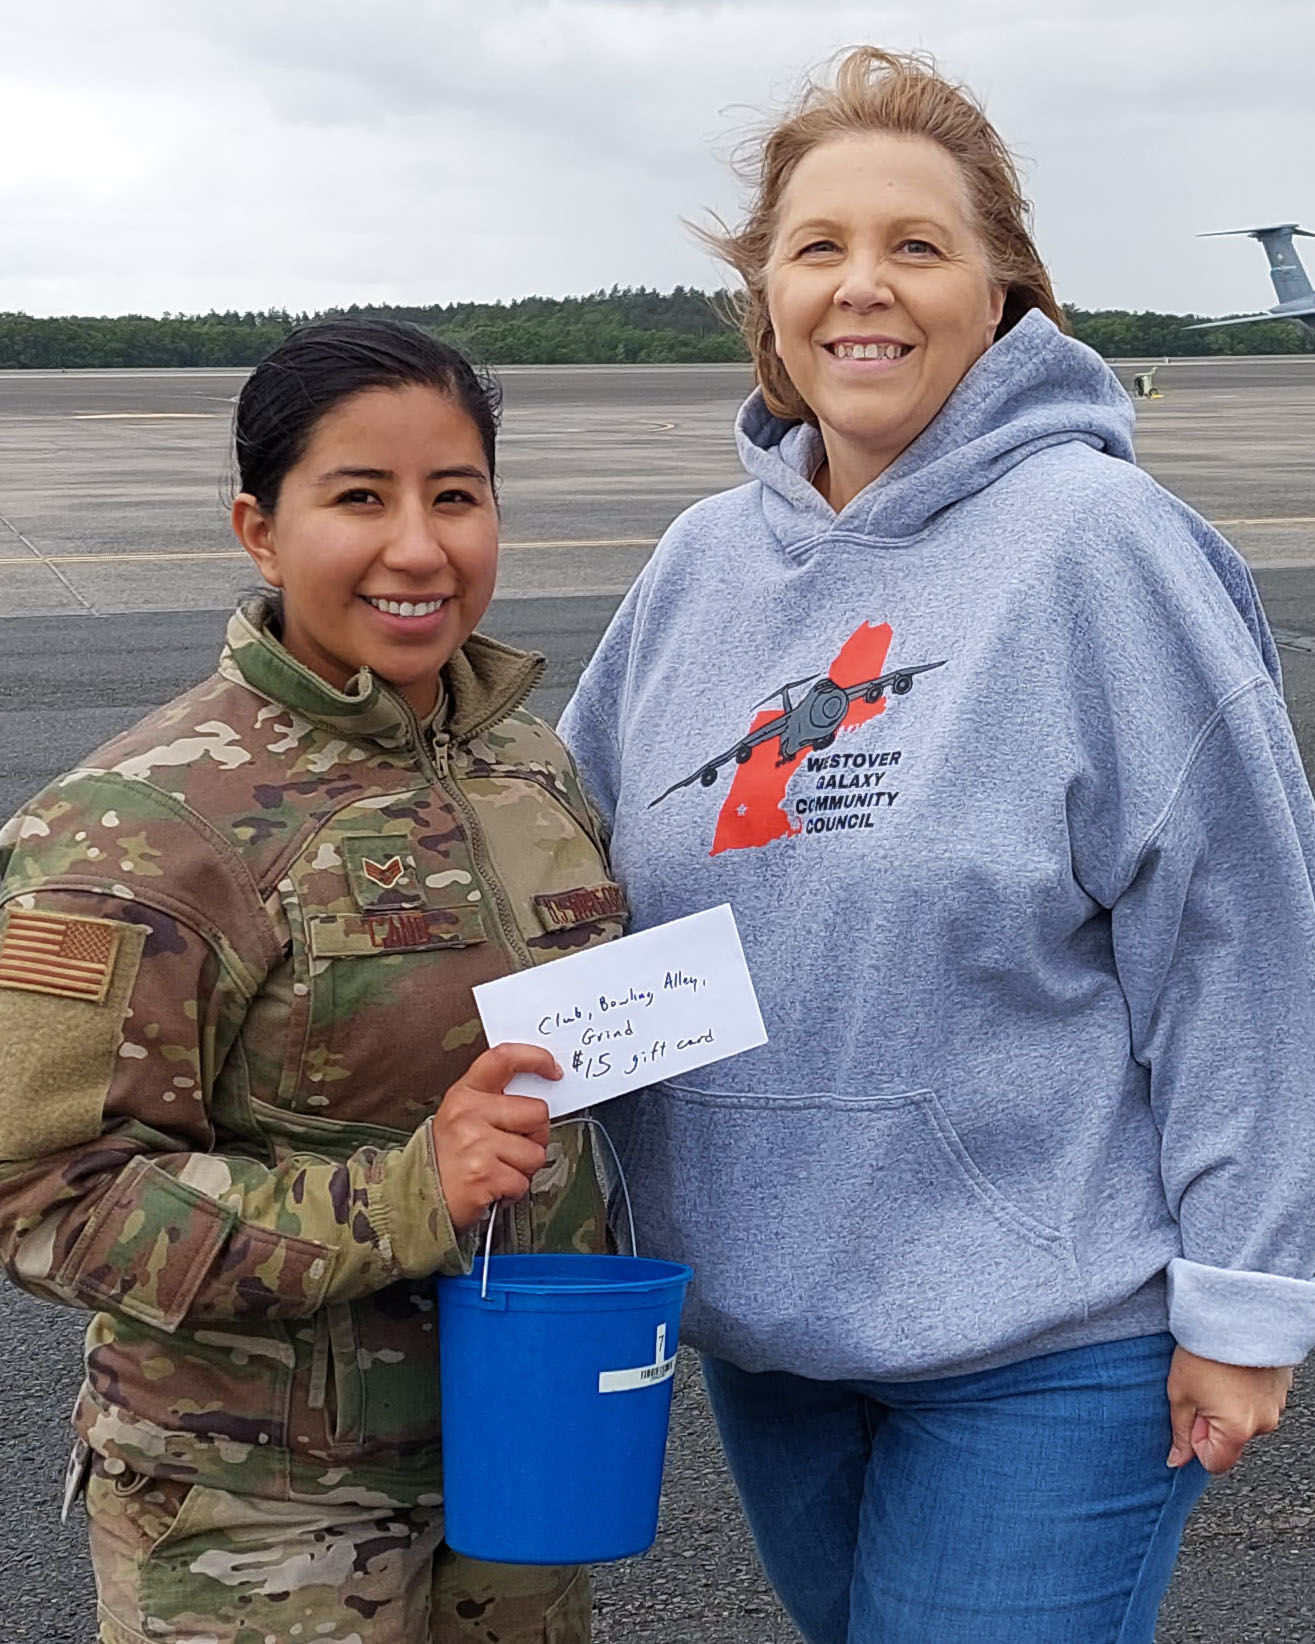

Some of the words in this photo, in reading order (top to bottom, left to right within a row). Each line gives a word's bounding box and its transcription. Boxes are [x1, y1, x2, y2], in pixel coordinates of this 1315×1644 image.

[807, 751, 902, 773] WESTOVER
[816, 772, 885, 790] GALAXY
[795, 793, 899, 814] COMMUNITY
[806, 814, 874, 835] COUNCIL
[538, 1007, 593, 1035] Club,
[599, 988, 655, 1012] Bowling
[664, 971, 707, 992] Alley,
[582, 1020, 634, 1045] Grind
[572, 1050, 612, 1079] $15
[624, 1042, 666, 1074] gift
[676, 1029, 714, 1050] card
[658, 1334, 665, 1352] 7
